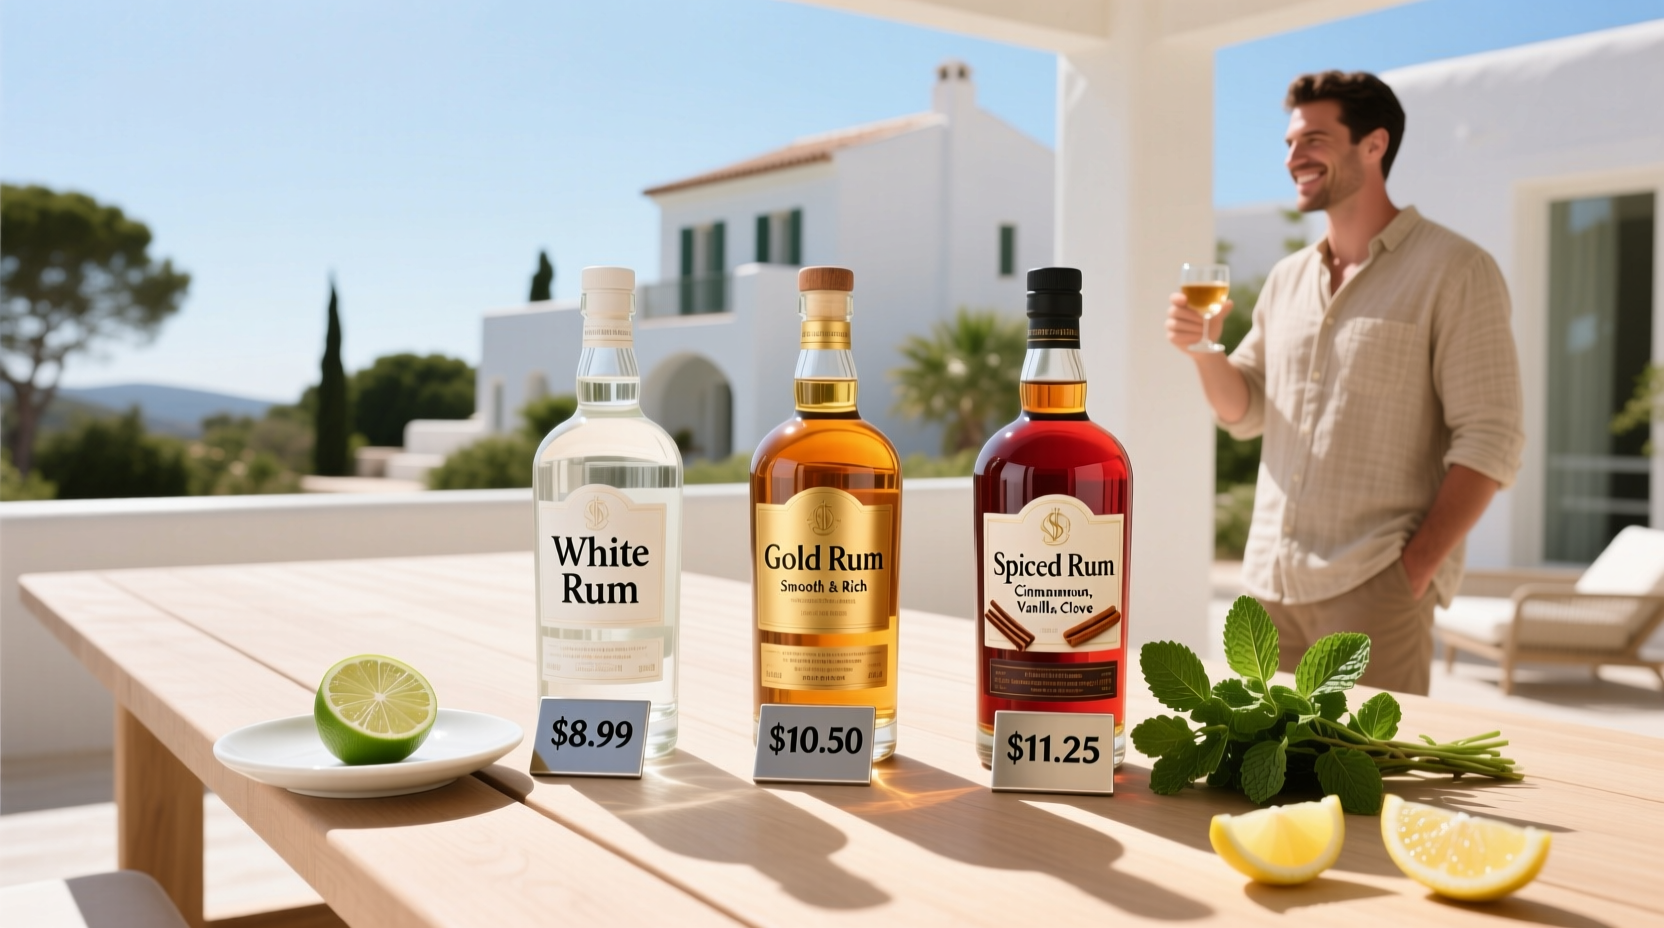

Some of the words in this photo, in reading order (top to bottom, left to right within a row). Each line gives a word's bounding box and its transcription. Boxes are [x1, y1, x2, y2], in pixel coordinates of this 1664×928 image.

[551, 535, 649, 567] White
[764, 543, 821, 571] Gold
[828, 545, 884, 571] Rum
[993, 551, 1062, 584] Spiced
[1067, 553, 1115, 577] Rum
[561, 572, 639, 605] Rum
[780, 579, 824, 593] Smooth
[828, 580, 838, 593] &
[842, 579, 867, 593] Rich
[1060, 601, 1093, 614] Clove
[551, 715, 633, 751] $8.99
[769, 722, 863, 756] $10.50
[1007, 730, 1100, 765] $11.25
